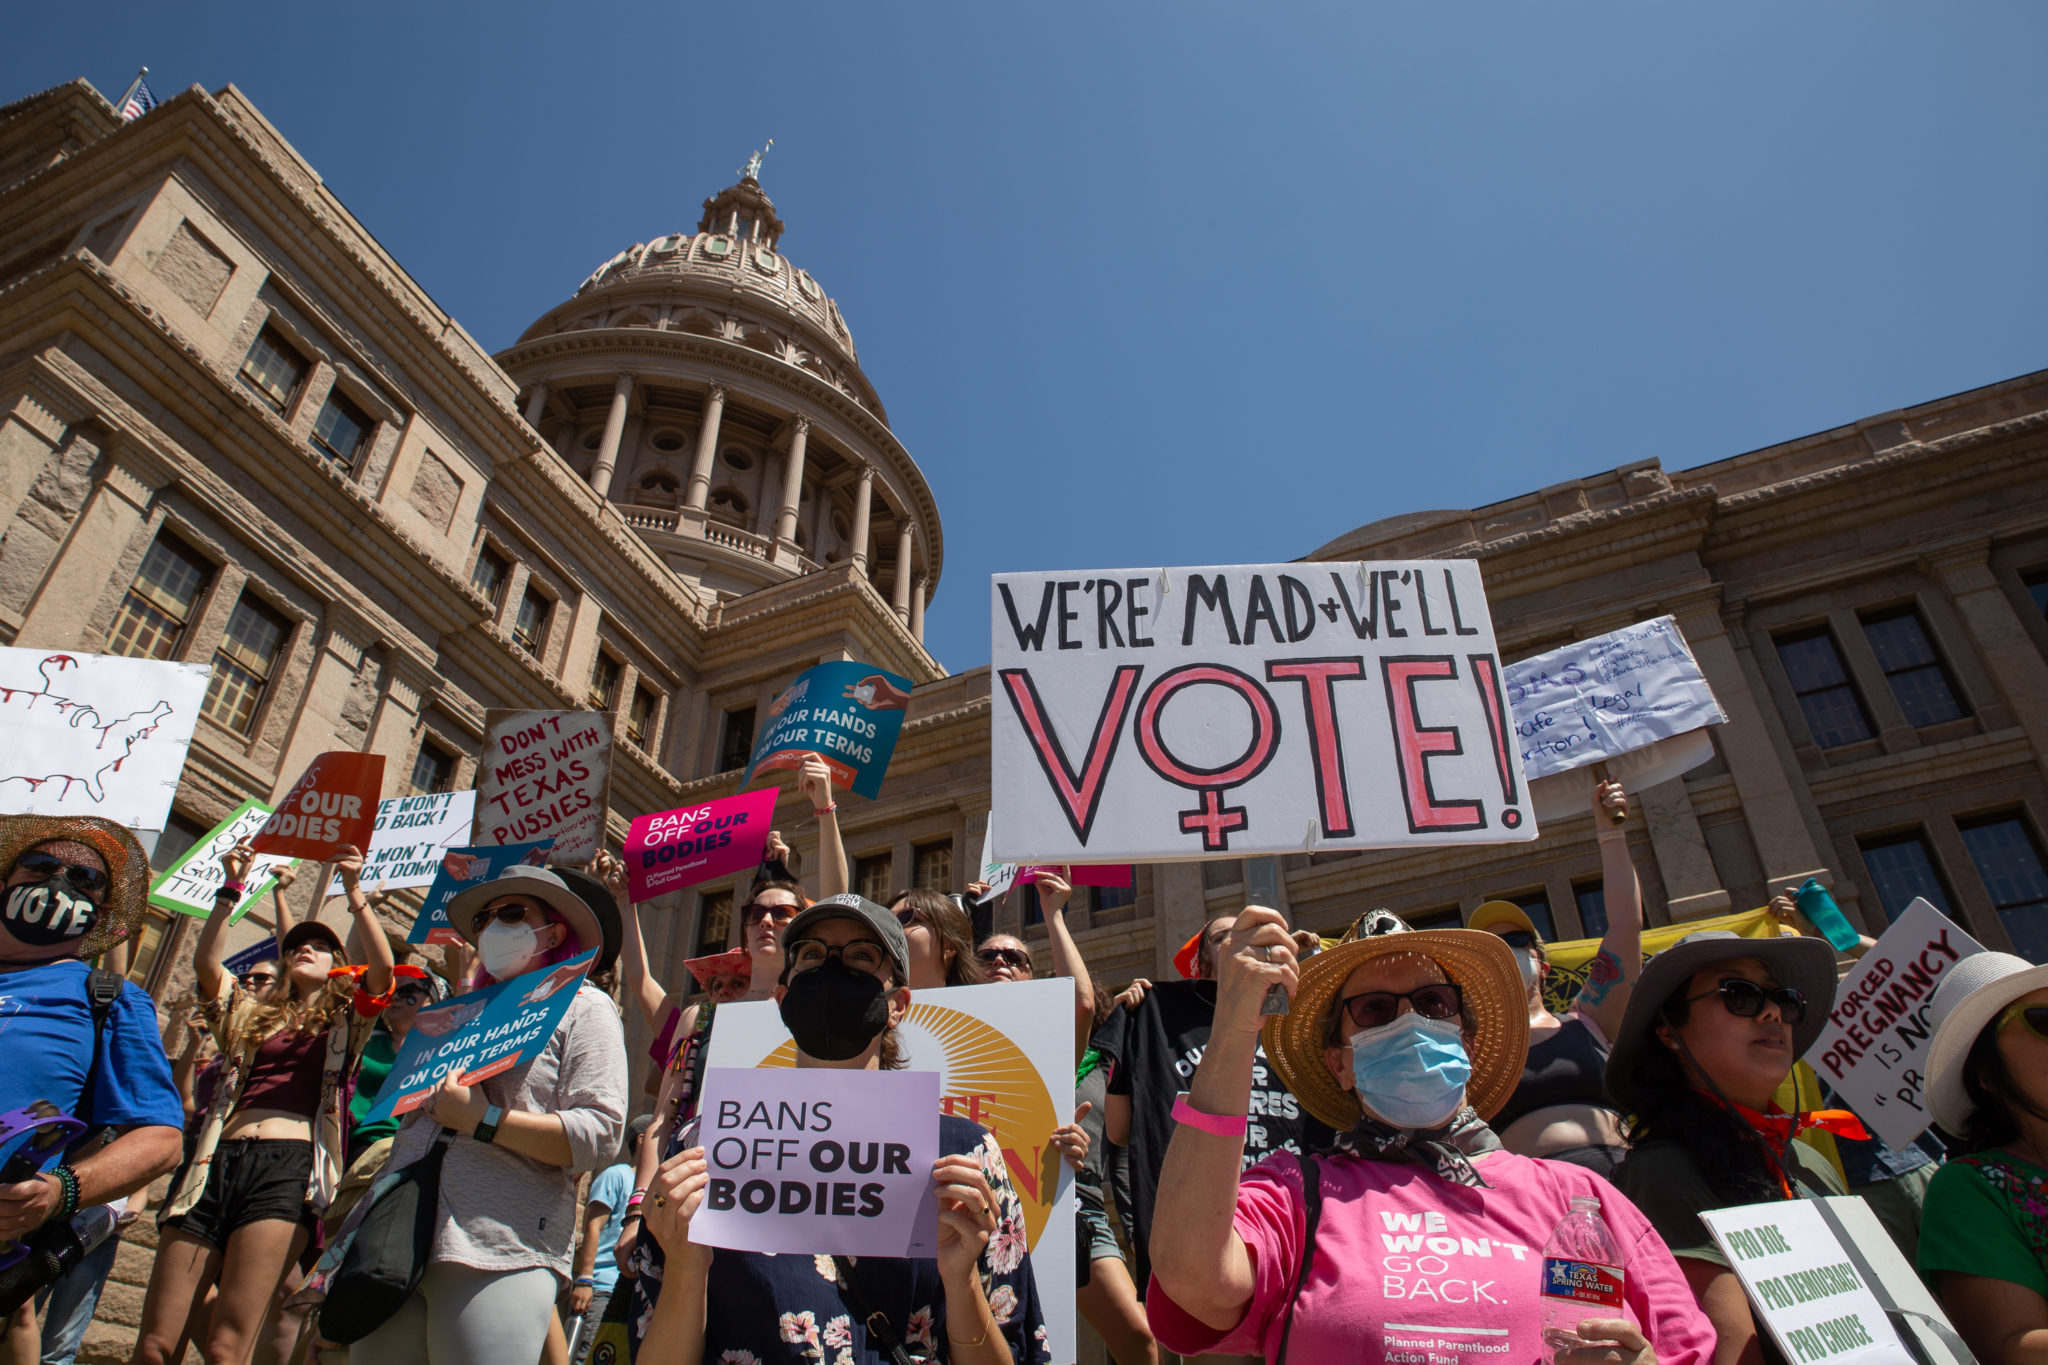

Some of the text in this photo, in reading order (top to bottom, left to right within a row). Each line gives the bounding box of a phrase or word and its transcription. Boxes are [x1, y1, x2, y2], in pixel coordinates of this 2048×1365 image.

[997, 578, 1154, 651] WE'RE
[1182, 574, 1316, 645] MAD
[1330, 568, 1479, 640] WE'LL
[1506, 662, 1587, 708] OMS
[1591, 682, 1643, 712] Legal
[500, 716, 561, 755] DON'T
[764, 708, 877, 741] IN OUR HANDS
[495, 727, 600, 786] MESS WITH
[756, 729, 873, 764] ON OUR TERMS
[997, 652, 1522, 851] VOTE!
[398, 793, 456, 812] WON'T
[490, 760, 590, 815] TEXAS
[300, 790, 362, 819] OUR
[373, 810, 448, 831] O BACK!
[492, 788, 592, 845] PUSSIES
[648, 806, 712, 831] BANS
[264, 813, 342, 842] ODIES
[644, 812, 749, 846] OFF OUR
[374, 841, 437, 863] WON'T
[642, 830, 732, 869] BODIES
[389, 859, 442, 879] DOWN
[653, 858, 707, 878] Planned Parenthood
[655, 873, 681, 886] Gulf Coast
[6, 886, 93, 935] VOTE
[836, 898, 860, 909] MOM
[1821, 928, 1960, 1080] PREGNANCY
[1829, 958, 1894, 1028] FORCED
[413, 1007, 550, 1066] IN OUR HANDS
[399, 1026, 543, 1090] ON OUR TERMS
[1175, 1044, 1208, 1077] OU
[1874, 1043, 1902, 1070] IS
[717, 1100, 833, 1132] BANS
[712, 1137, 912, 1175] OFF OUR
[707, 1178, 886, 1217] BODIES
[1380, 1211, 1448, 1233] WE
[1380, 1234, 1529, 1261] WON'T
[1725, 1224, 1792, 1261] PRO ROE
[1383, 1255, 1449, 1275] GO
[1569, 1271, 1598, 1282] TEXAS
[1383, 1275, 1508, 1305] BACK.
[1552, 1277, 1614, 1293] SPRING WATER
[1754, 1261, 1863, 1311] PRO DEMOCRACY
[1384, 1336, 1510, 1354] Planned Parenthood
[1786, 1313, 1874, 1364] PRO CHOICE
[1385, 1351, 1459, 1365] Action Fund
